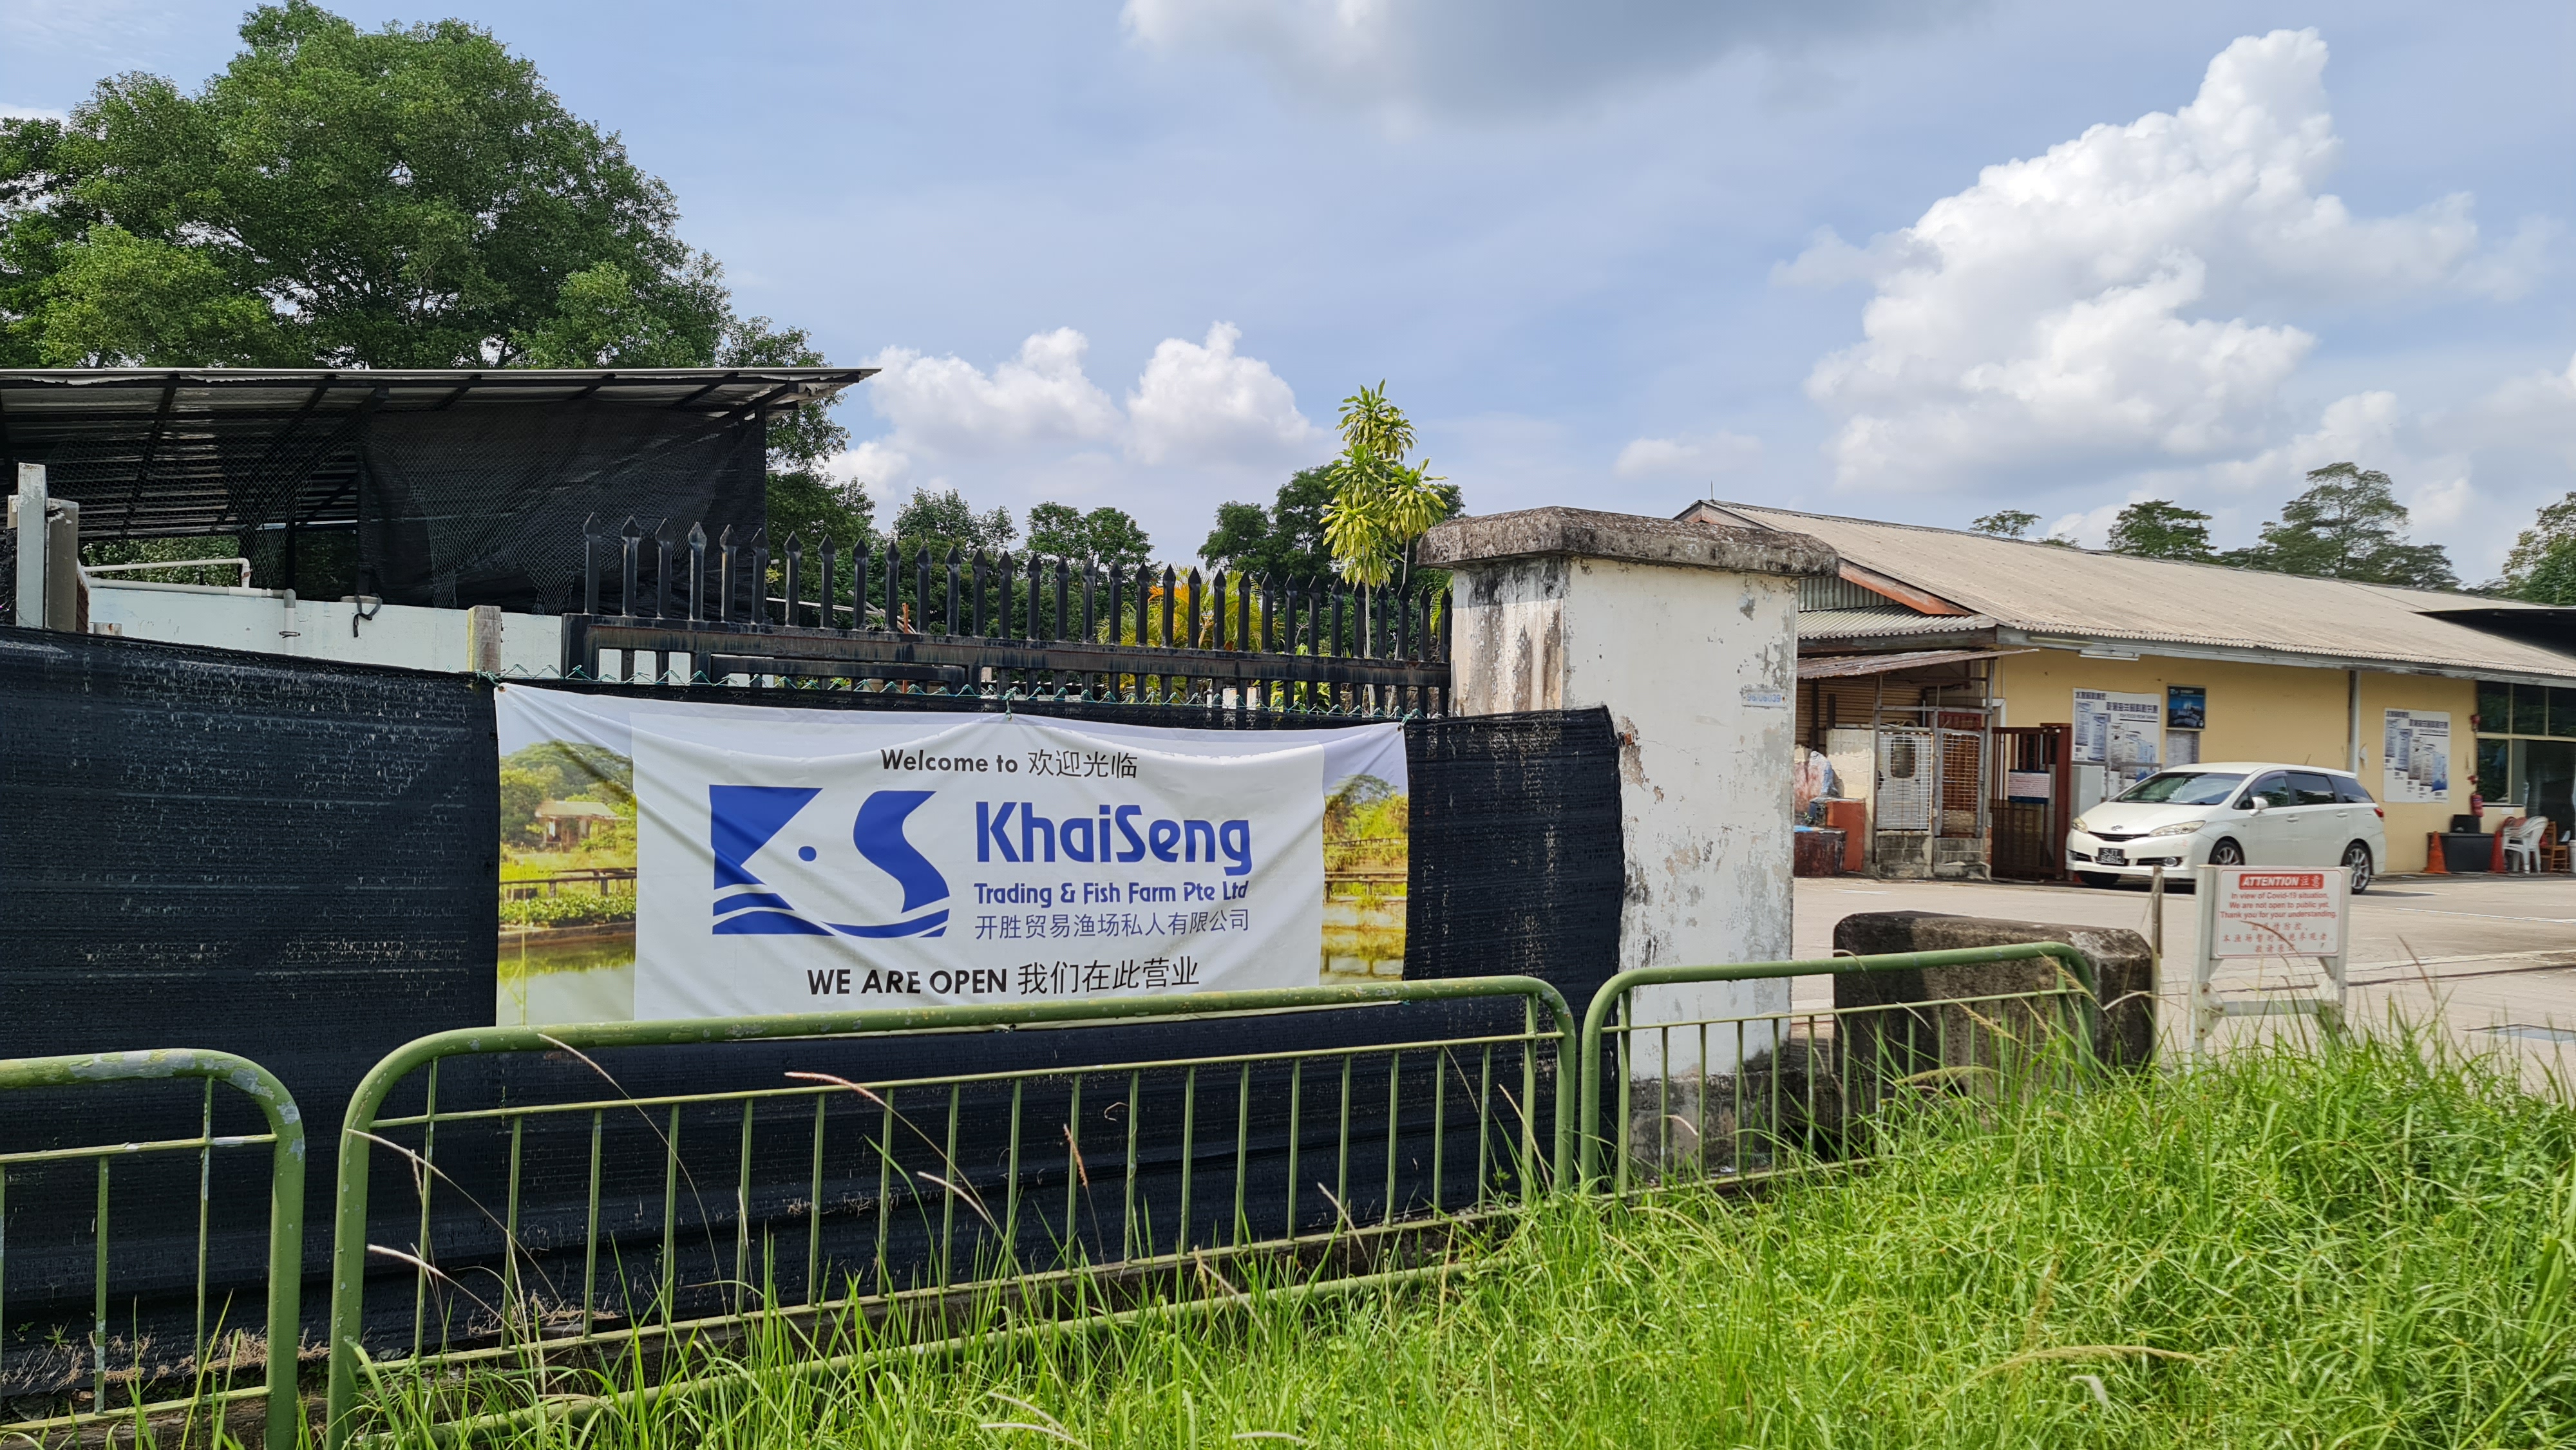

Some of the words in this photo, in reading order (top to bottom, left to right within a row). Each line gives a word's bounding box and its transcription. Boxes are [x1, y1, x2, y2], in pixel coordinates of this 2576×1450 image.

[880, 749, 989, 772] Welcome
[996, 755, 1018, 773] to
[1027, 749, 1138, 778] 欢迎光临
[976, 801, 1253, 876] KhaiSeng
[974, 882, 1052, 909] Trading
[1060, 882, 1075, 903] &
[1083, 881, 1121, 905] Fish
[1128, 881, 1177, 905] Farm
[1183, 881, 1215, 901] Pte
[1222, 880, 1249, 901] Ltd
[2242, 876, 2299, 887] ATTENTION
[974, 909, 1249, 940] 开胜贸易渔场私人有限公司
[807, 969, 851, 995] WE
[860, 969, 922, 994] ARE
[929, 968, 1007, 994] OPEN
[1018, 956, 1200, 996] 我们在此营业
